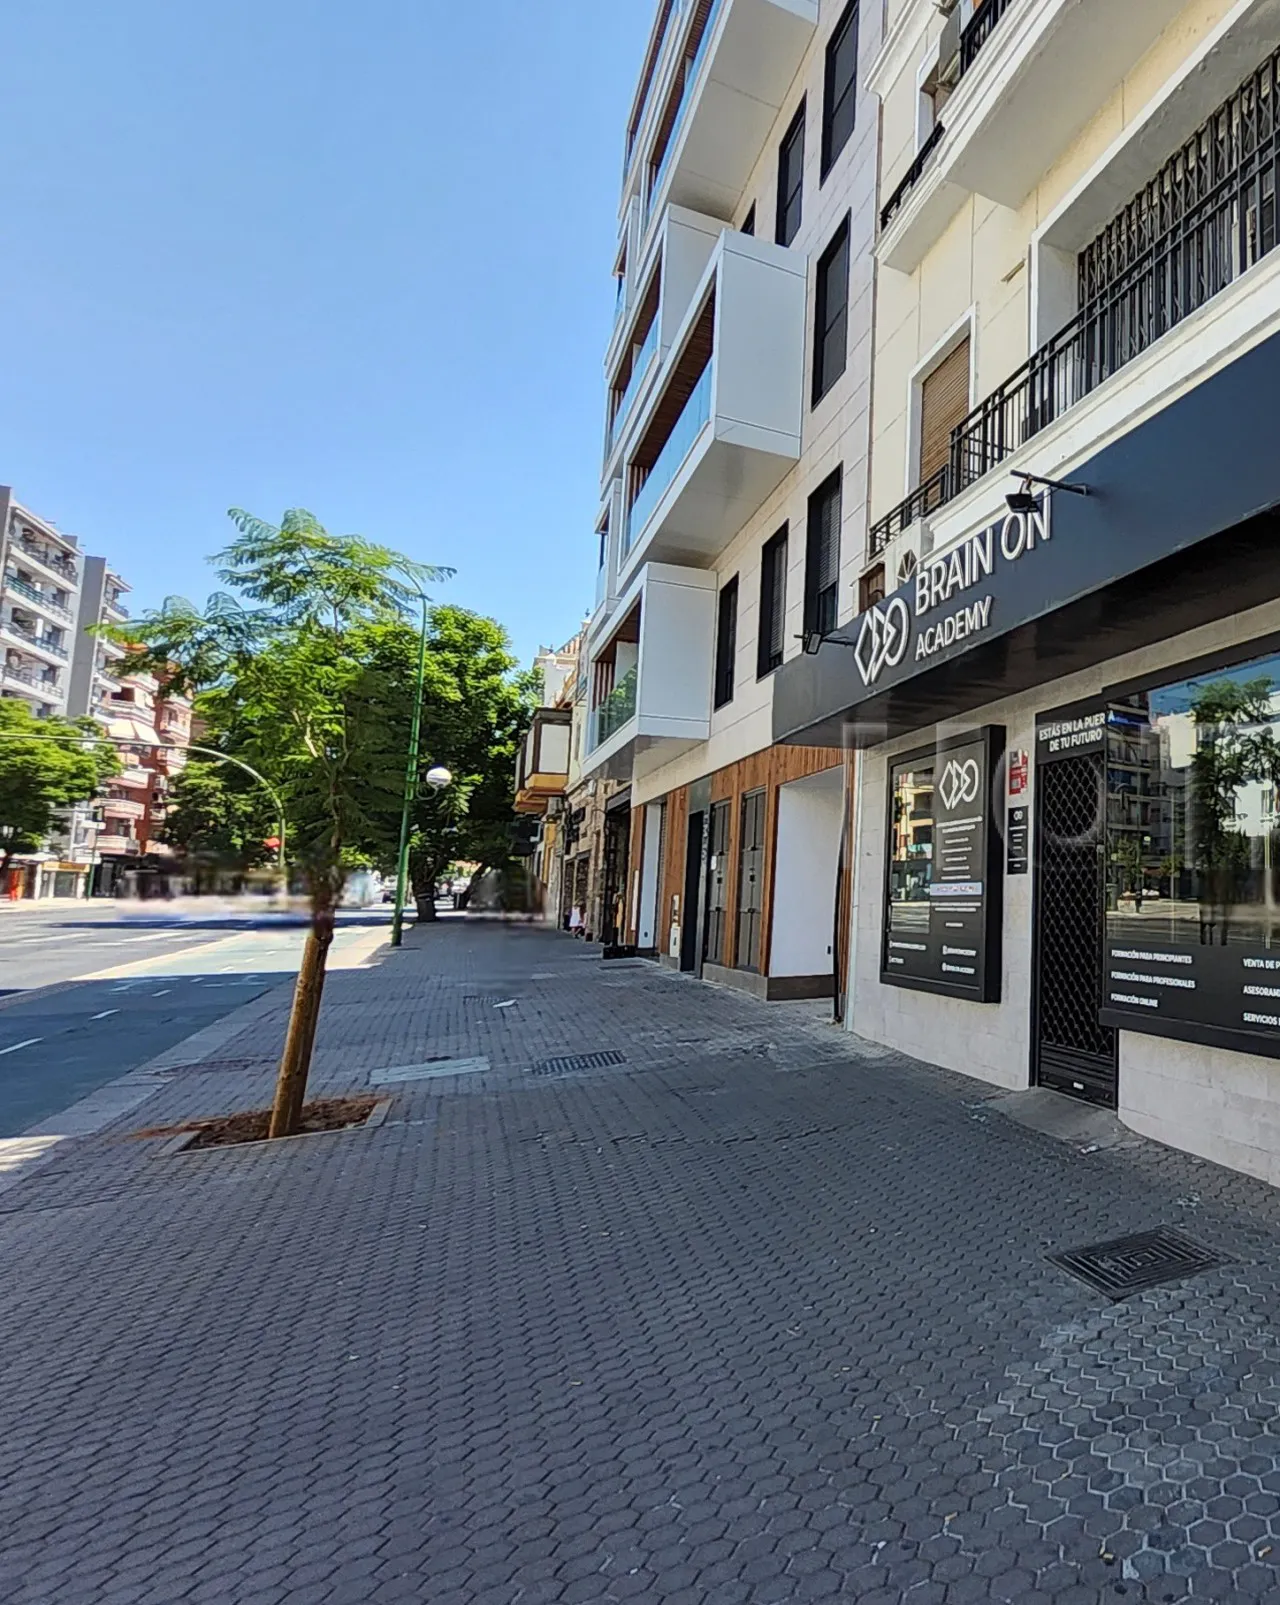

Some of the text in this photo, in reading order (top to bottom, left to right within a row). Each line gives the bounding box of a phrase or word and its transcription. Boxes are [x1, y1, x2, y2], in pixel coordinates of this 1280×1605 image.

[915, 489, 1051, 616] BRAIN ON
[915, 594, 993, 661] ACADEMY
[1039, 723, 1060, 741] ESTÁS
[1061, 721, 1072, 735] EN
[1073, 717, 1084, 732] LA
[1049, 728, 1102, 752] DE TU FUTURO
[1242, 958, 1265, 969] VENTA
[1265, 960, 1275, 970] DE
[1243, 1012, 1278, 1026] SERVICIOS
